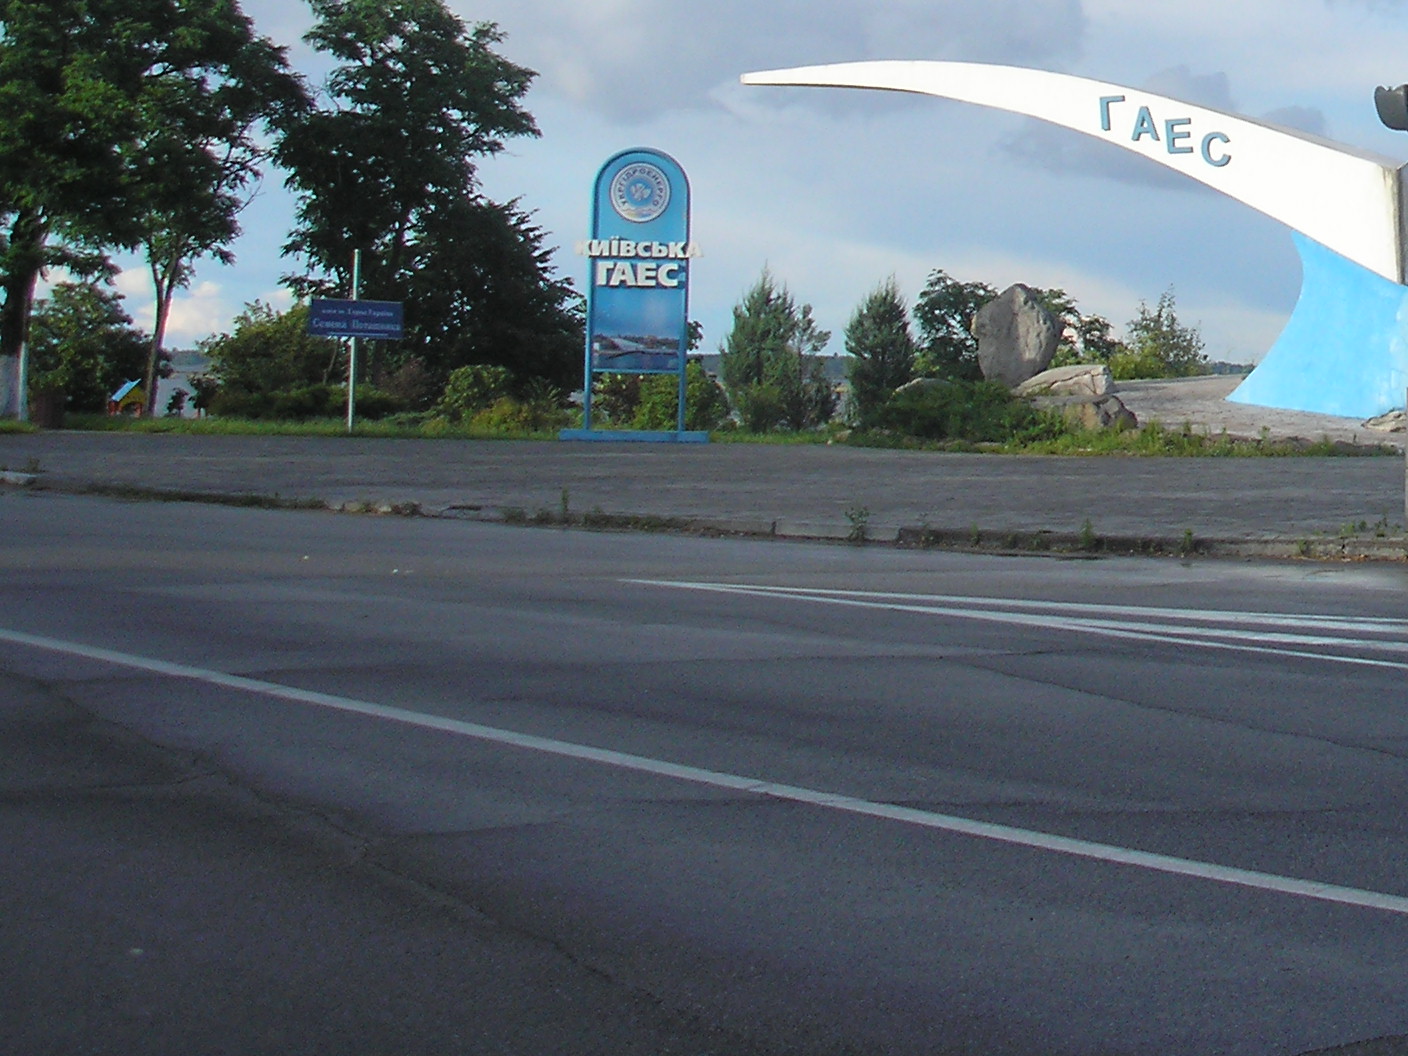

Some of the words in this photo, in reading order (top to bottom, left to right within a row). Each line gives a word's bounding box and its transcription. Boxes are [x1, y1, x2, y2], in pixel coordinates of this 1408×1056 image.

[1099, 95, 1231, 167] ГАЕС
[575, 235, 704, 258] КИЇВСЬКА
[596, 261, 679, 286] ГАЕС
